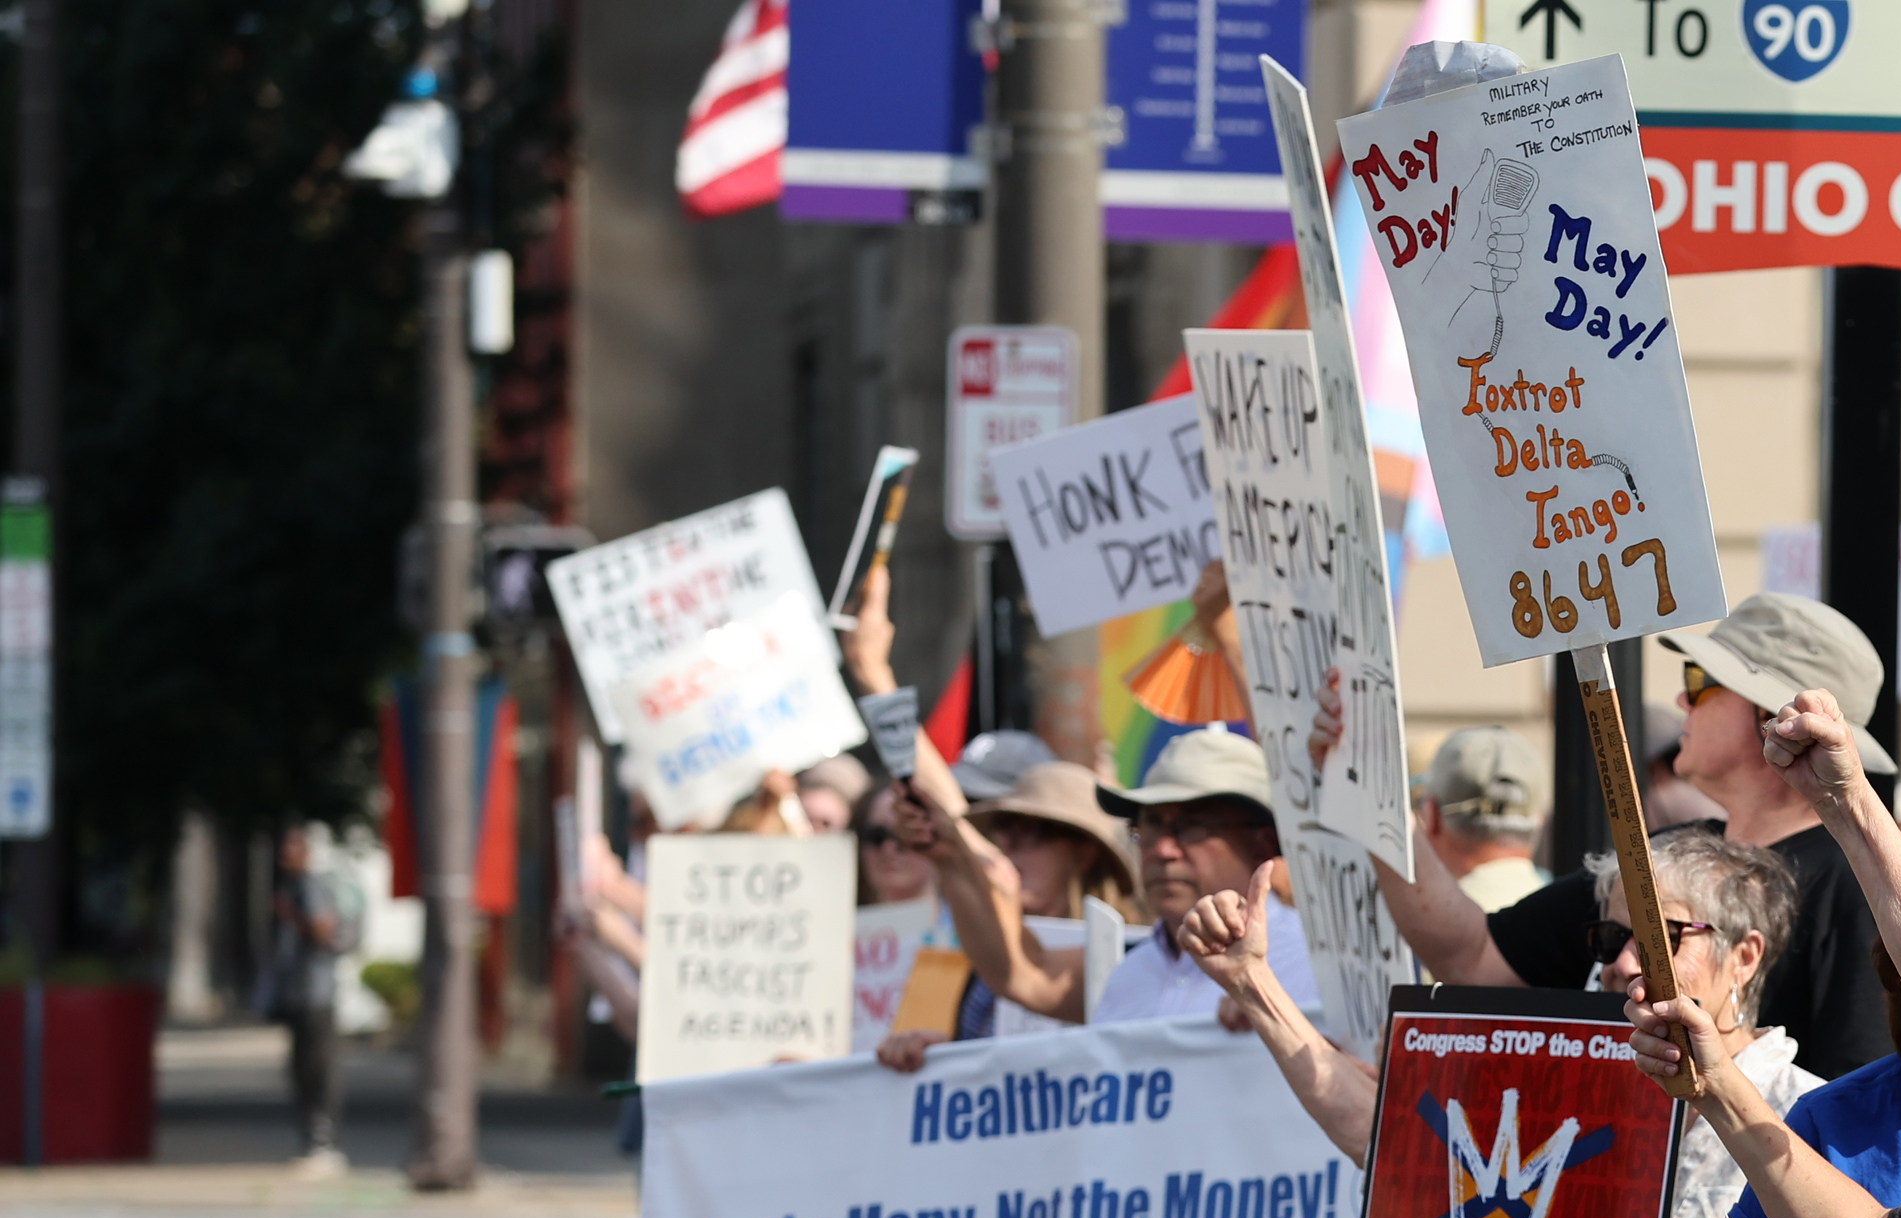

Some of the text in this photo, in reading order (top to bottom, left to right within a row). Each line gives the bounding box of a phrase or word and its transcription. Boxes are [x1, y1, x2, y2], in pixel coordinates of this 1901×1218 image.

[1637, 0, 1836, 63] To 90
[1480, 102, 1542, 126] REMEMBER
[1575, 89, 1604, 107] OATH
[1489, 77, 1549, 102] MILITARY
[1530, 118, 1555, 132] TO
[1352, 131, 1440, 211] May
[1516, 120, 1633, 159] THE CONSTITUTION
[1377, 186, 1459, 269] Day!
[1645, 158, 1869, 237] OHIO
[1544, 203, 1647, 299] May
[1545, 276, 1669, 360] Day!
[1194, 352, 1319, 474] WAKE UP
[1457, 352, 1585, 416] Foxtrot
[1491, 424, 1593, 477] Delta
[1017, 447, 1170, 551] HONK
[1223, 480, 1337, 582] AMERICA
[1098, 521, 1222, 602] DEMO
[1509, 538, 1677, 639] 8647
[1587, 709, 1621, 821] CHEVROLET
[684, 862, 801, 905] STOP
[676, 959, 816, 1003] FASCIST
[679, 1009, 836, 1055] AGENDA!
[1403, 1027, 1487, 1058] Congress
[1489, 1029, 1546, 1056] STOP
[1548, 1033, 1585, 1058] the
[910, 1067, 1176, 1145] Healthcare
